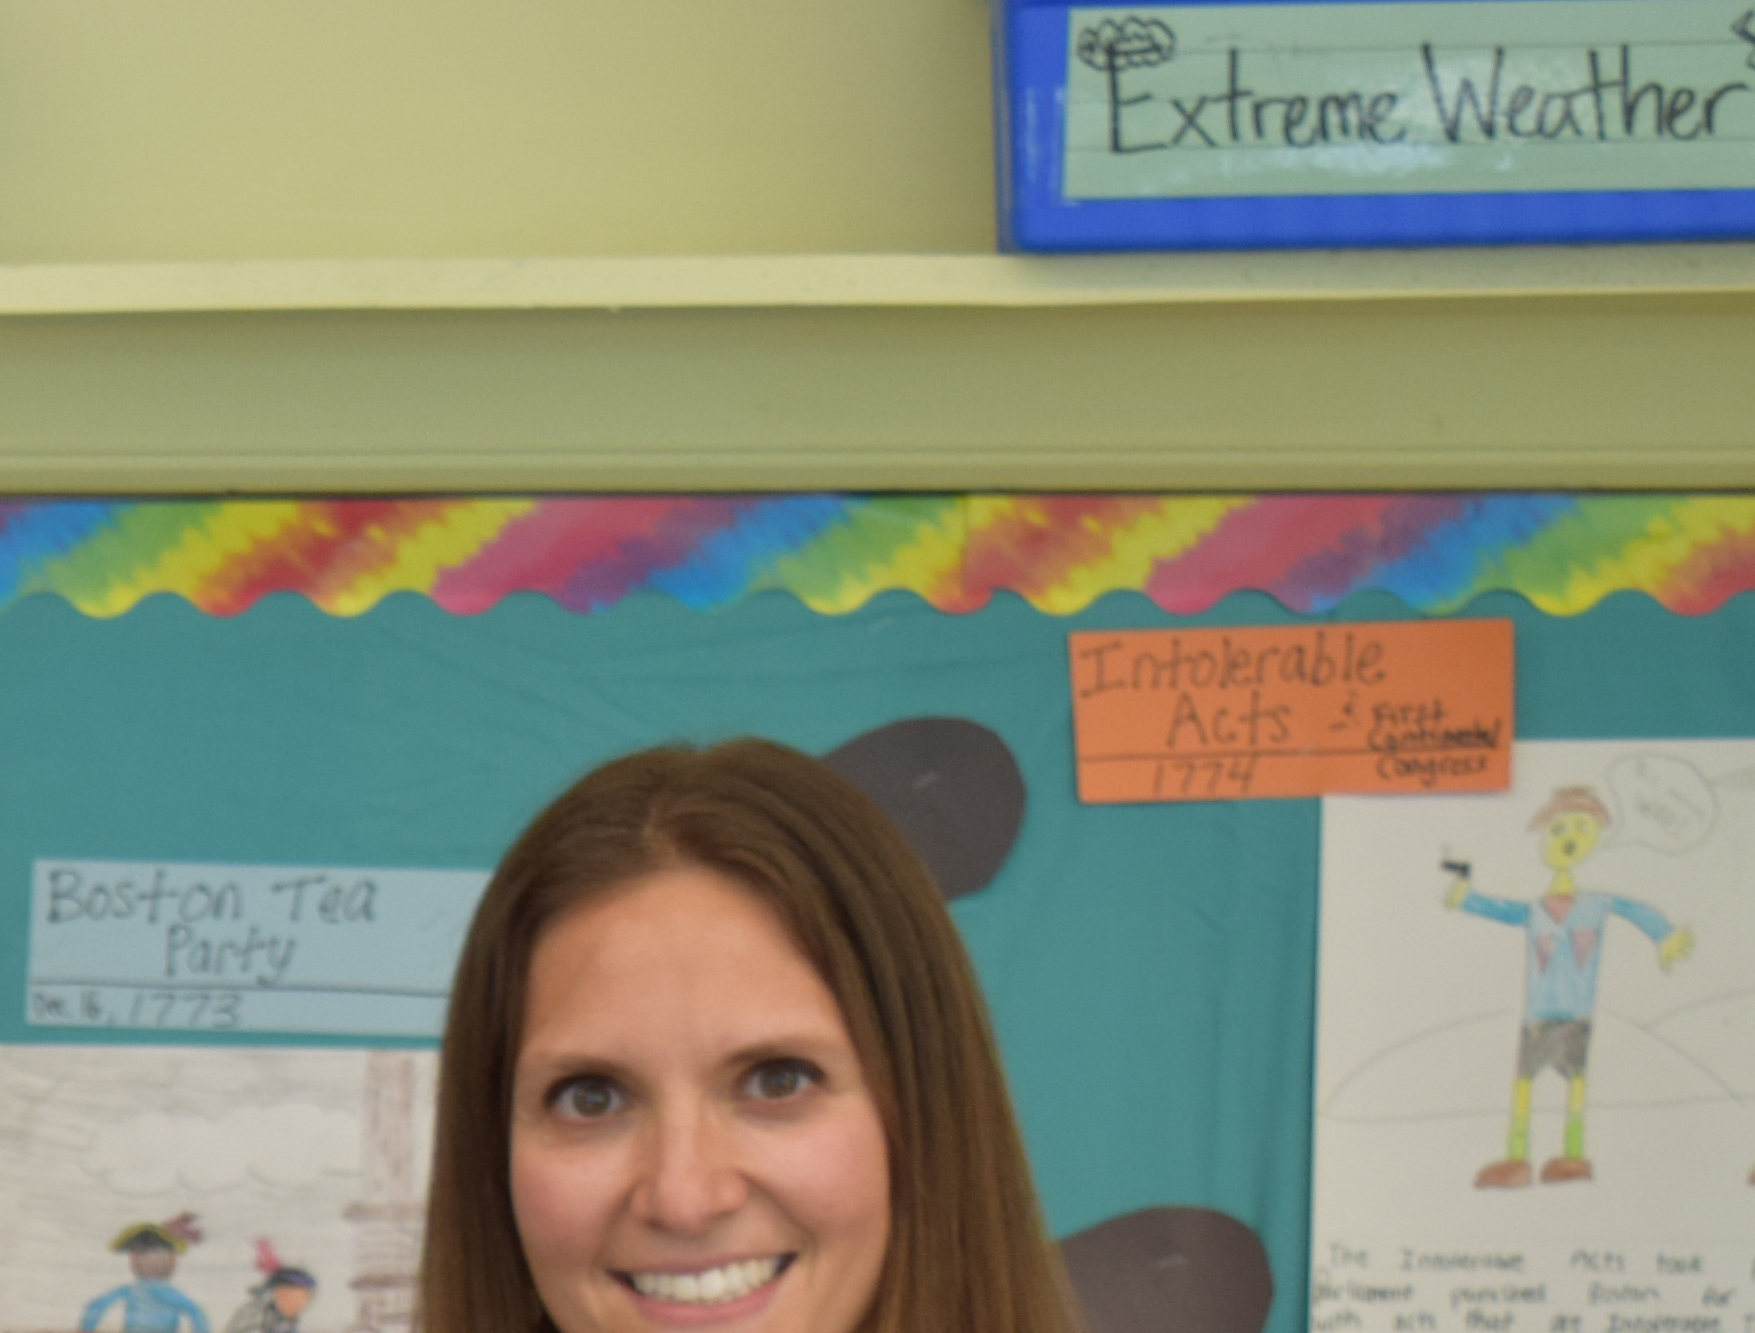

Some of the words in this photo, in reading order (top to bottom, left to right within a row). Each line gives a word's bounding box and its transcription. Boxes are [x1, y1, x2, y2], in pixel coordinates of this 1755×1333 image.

[1107, 42, 1409, 155] Extreme
[1420, 42, 1752, 147] Weather
[1078, 631, 1387, 699] Intolerable
[1165, 690, 1291, 749] Acts
[1152, 757, 1263, 795] 1774
[46, 868, 244, 925] Boston
[270, 874, 379, 926] Tea
[163, 922, 299, 987] Party
[128, 990, 242, 1030] 1773
